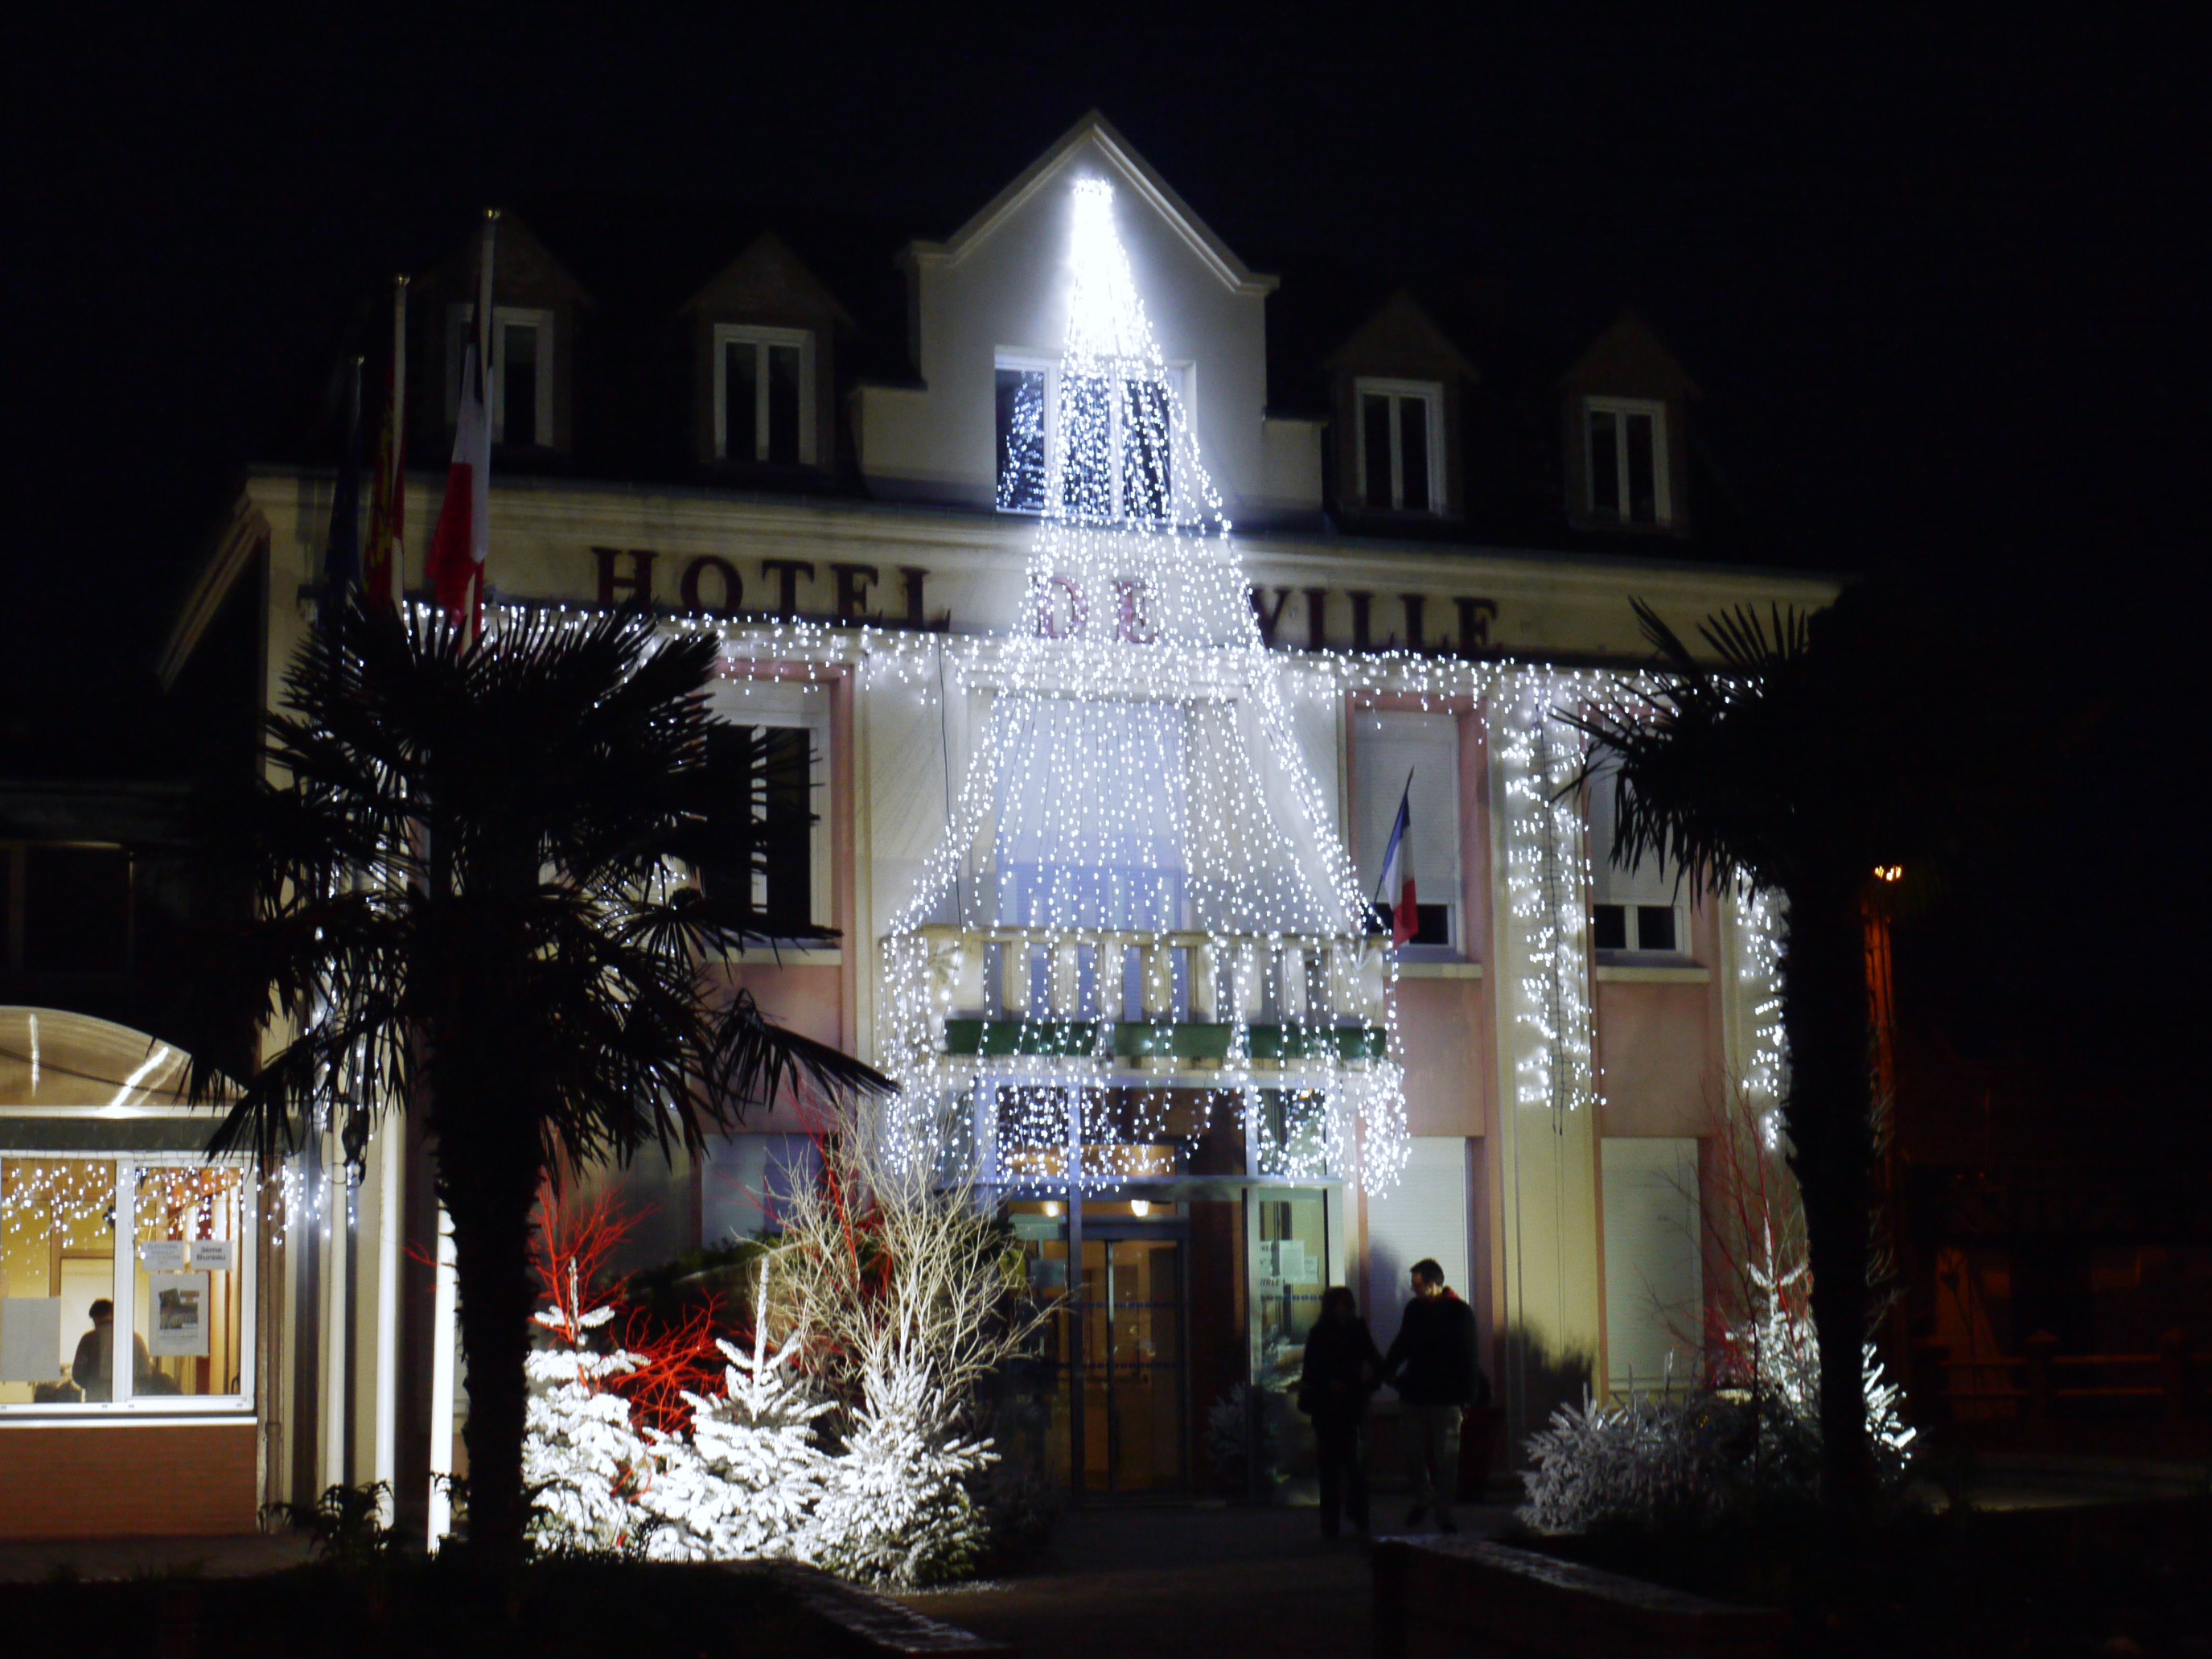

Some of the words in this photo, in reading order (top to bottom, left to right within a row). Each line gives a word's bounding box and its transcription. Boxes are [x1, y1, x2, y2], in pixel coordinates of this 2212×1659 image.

[592, 546, 951, 632] HOTEL
[1032, 575, 1162, 644] DE
[1247, 586, 1504, 661] VILLE
